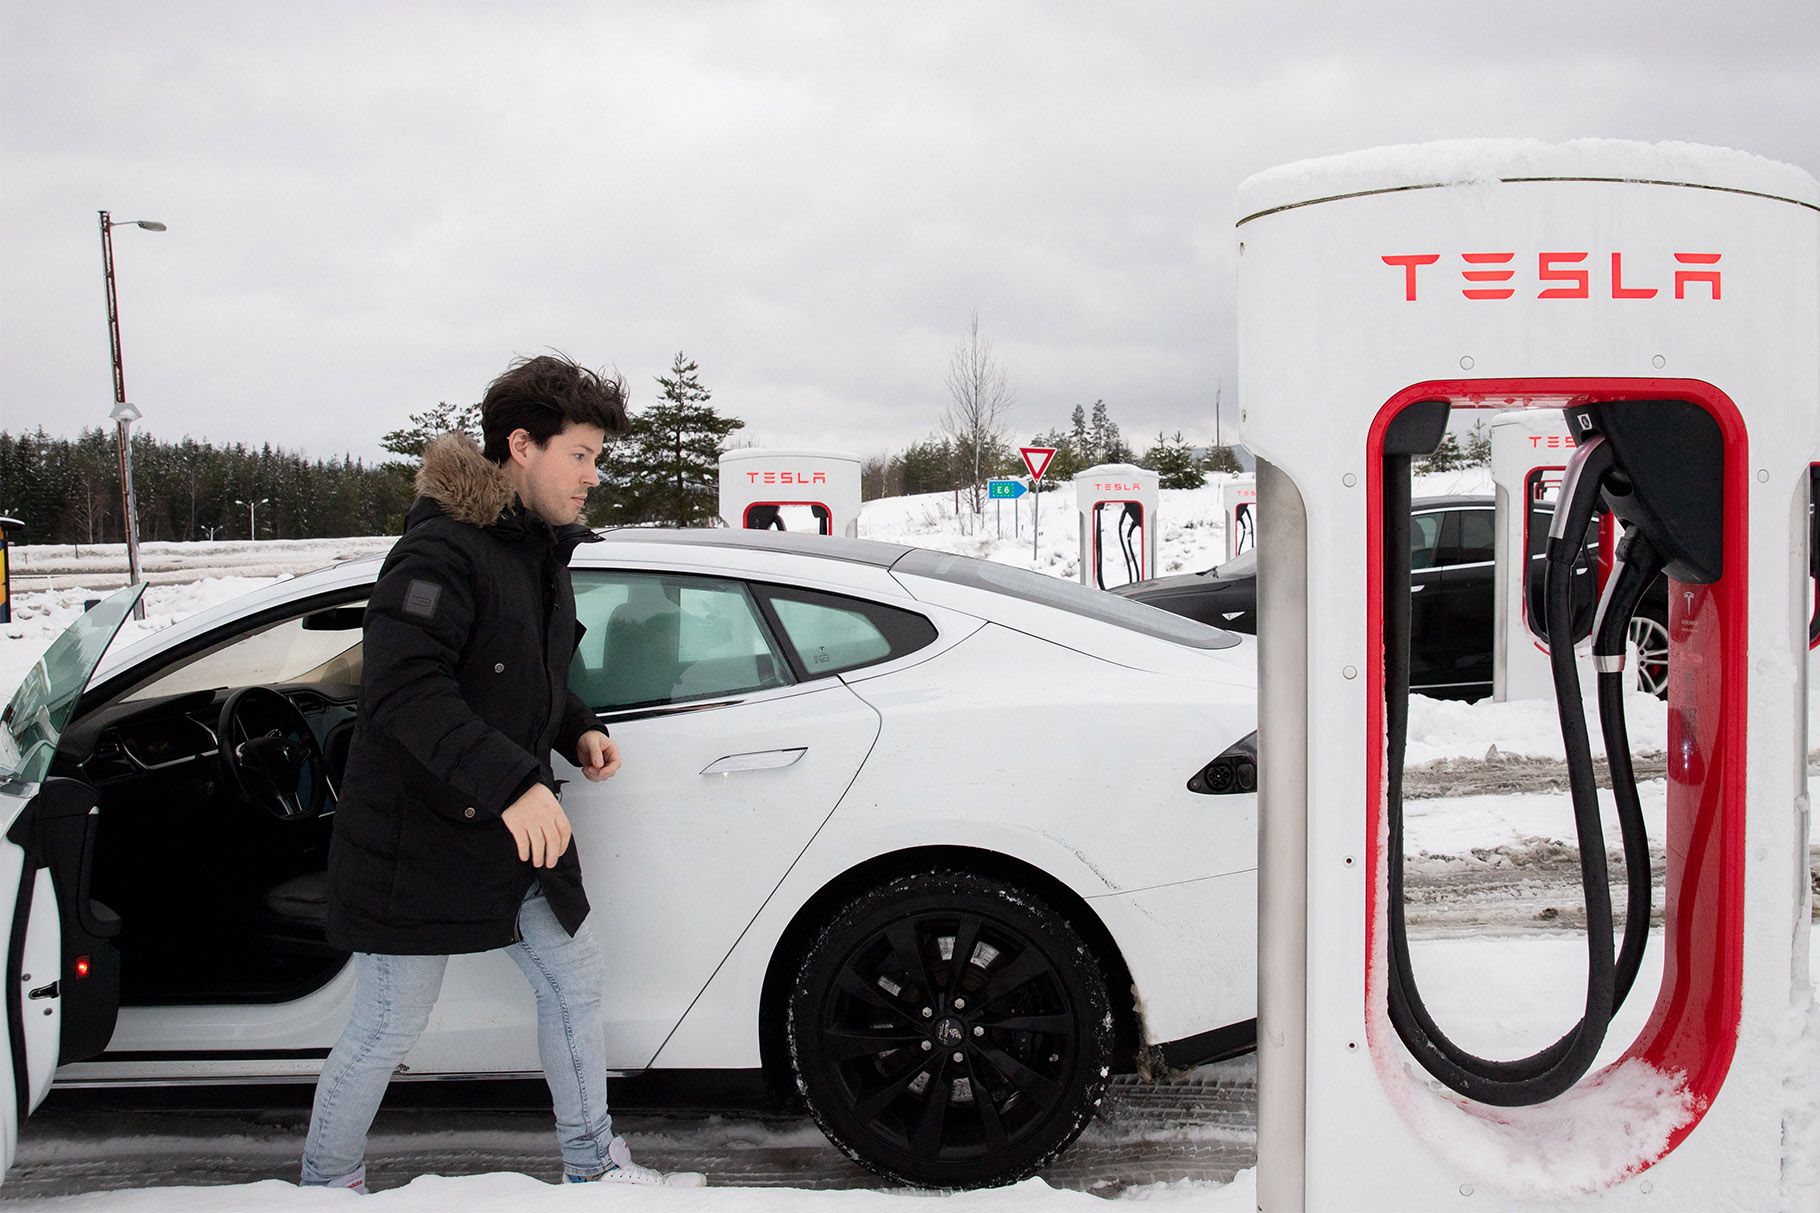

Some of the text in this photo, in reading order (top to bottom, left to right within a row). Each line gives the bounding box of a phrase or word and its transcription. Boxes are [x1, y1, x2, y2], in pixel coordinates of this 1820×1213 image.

[1381, 251, 1722, 302] TESLA
[1528, 435, 1577, 449] TES
[745, 471, 827, 485] TESLA
[1094, 482, 1141, 491] TESLA
[1234, 489, 1257, 497] TES
